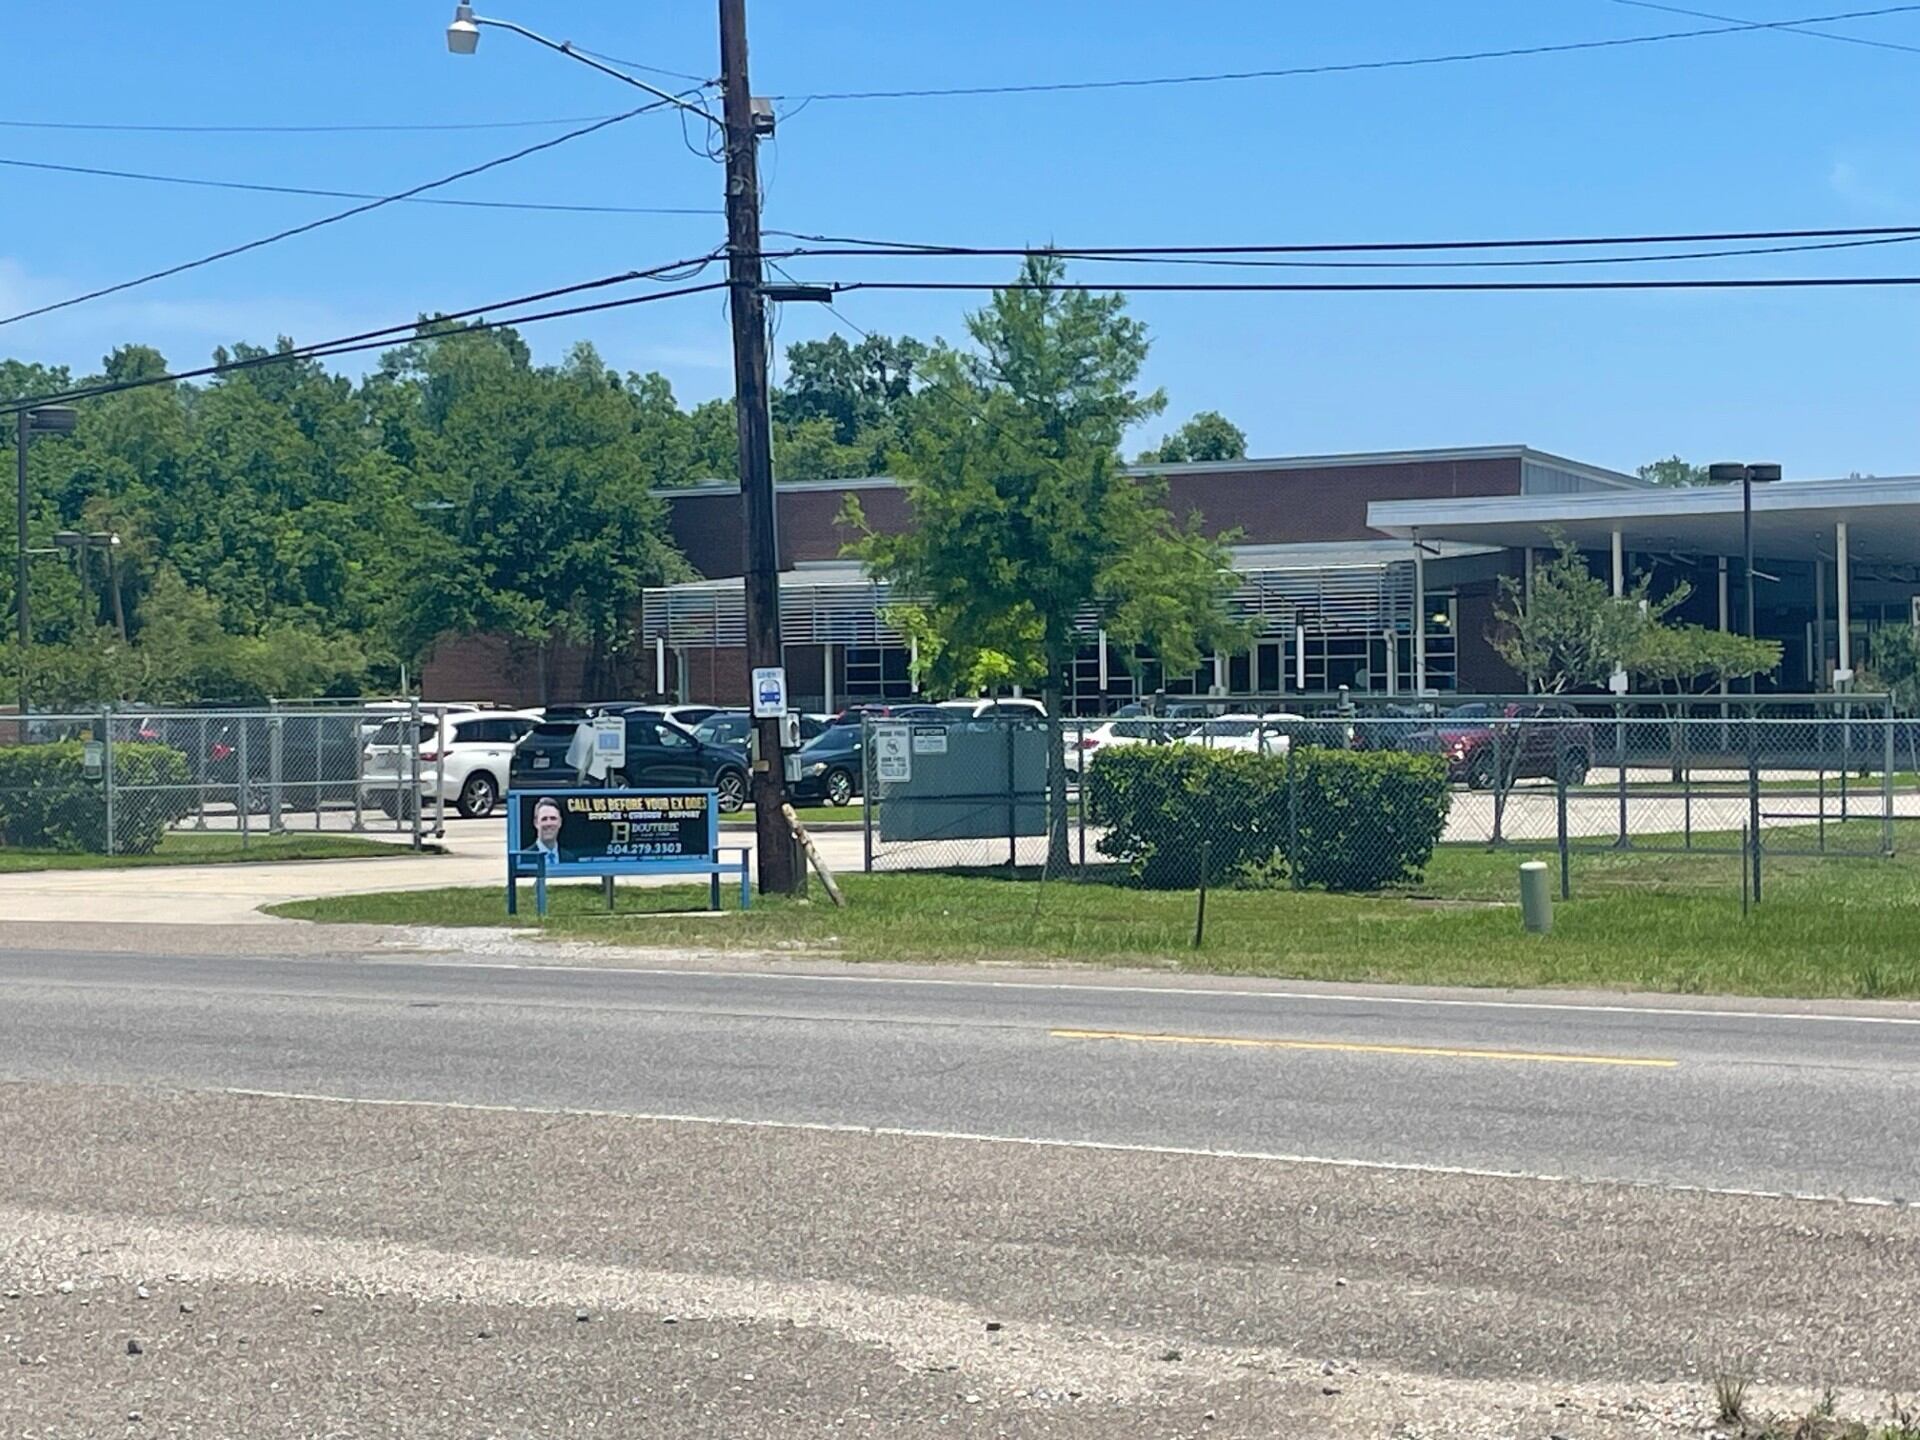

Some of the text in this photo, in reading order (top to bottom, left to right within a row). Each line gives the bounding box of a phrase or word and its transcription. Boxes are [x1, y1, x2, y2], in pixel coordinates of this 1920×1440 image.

[567, 798, 592, 812] CALL
[593, 798, 606, 811] US
[608, 797, 644, 811] BEFORE
[646, 797, 669, 810] YOUR
[671, 797, 684, 810] EX
[606, 843, 682, 855] 504.279.3303
